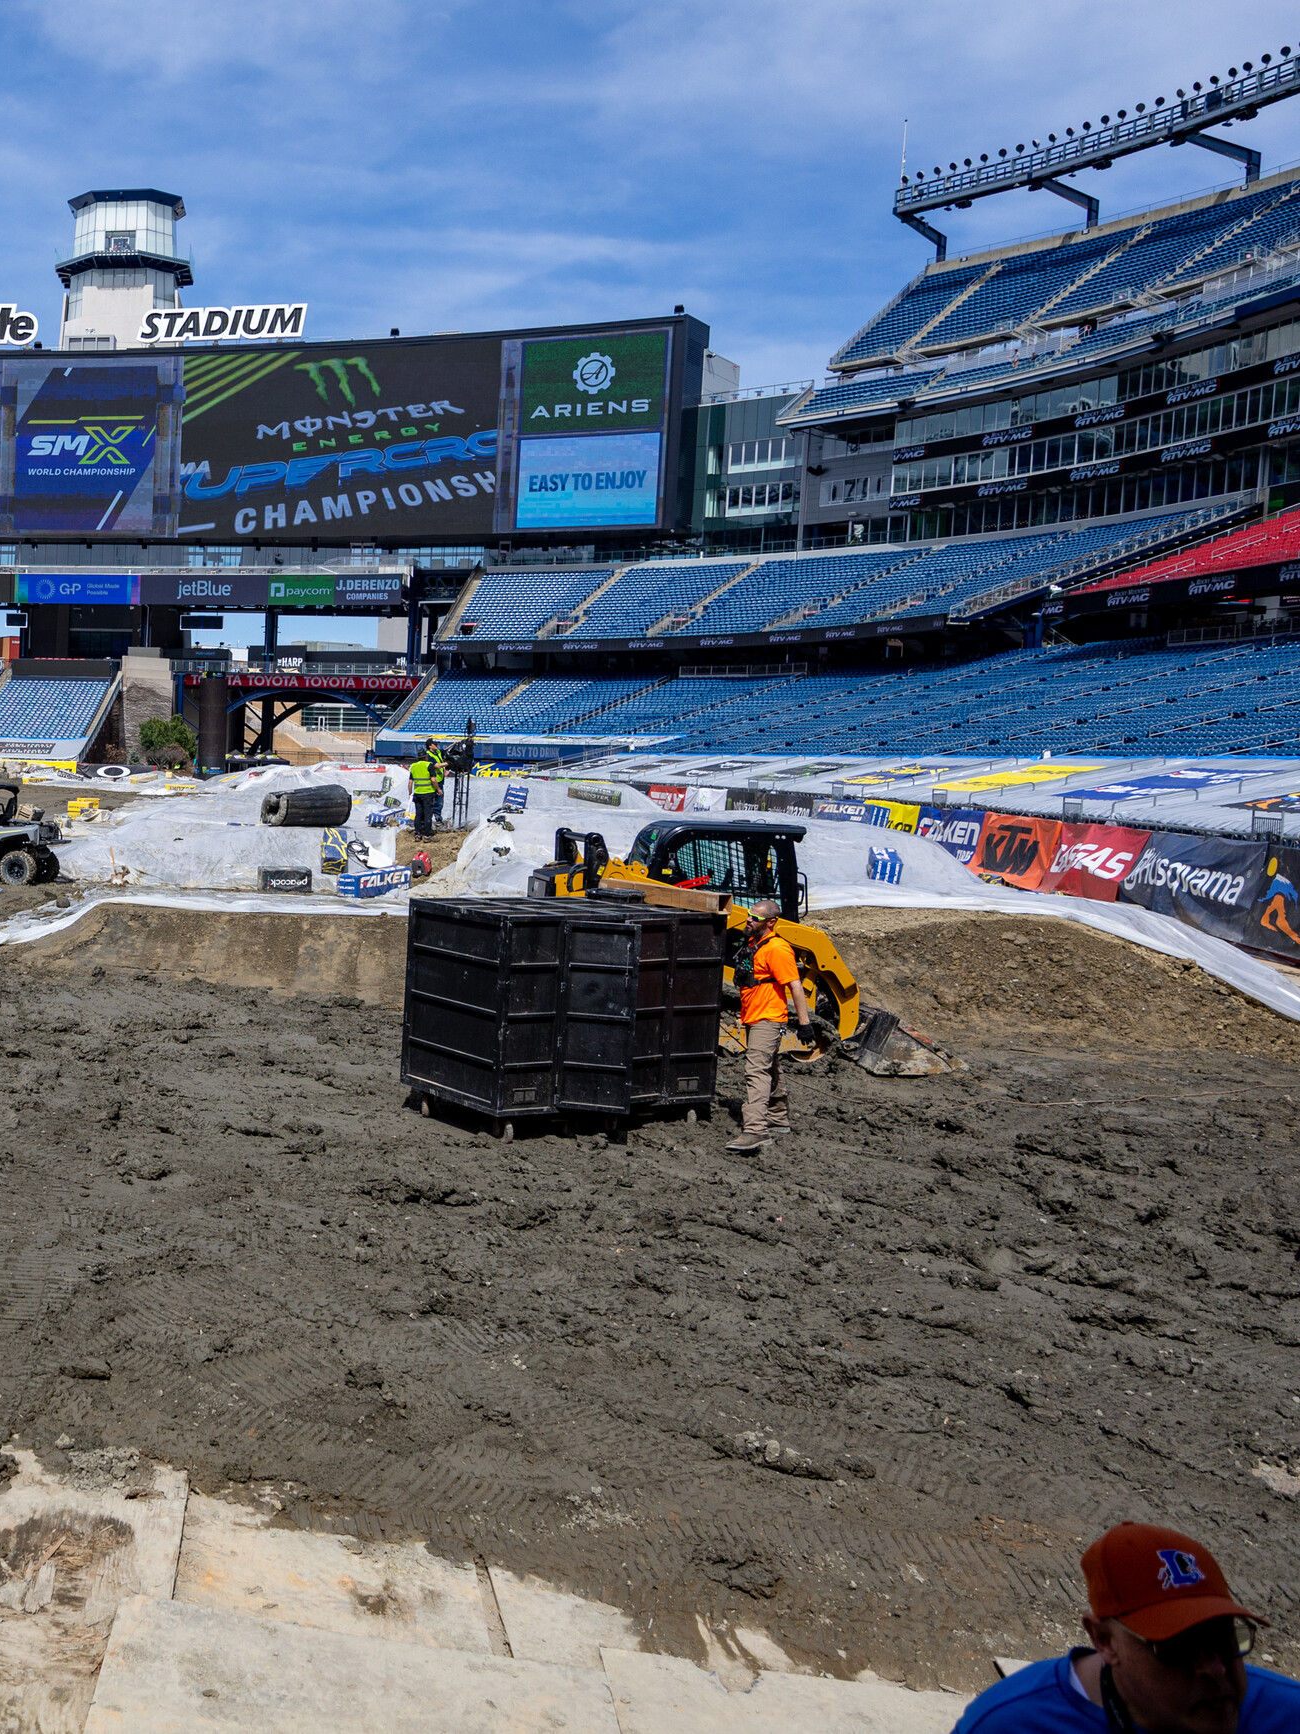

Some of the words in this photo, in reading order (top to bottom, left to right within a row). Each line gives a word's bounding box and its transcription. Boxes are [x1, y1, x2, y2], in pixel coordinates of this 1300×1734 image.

[140, 307, 304, 339] STADIUM
[530, 399, 650, 419] ARIENS
[256, 399, 465, 440] MONSTER
[27, 425, 137, 465] SMX
[292, 422, 441, 452] ENERGY
[28, 467, 61, 476] WORLD
[63, 467, 136, 476] CHAMPIONSHIP
[528, 472, 568, 493] EASY
[572, 472, 593, 491] TO
[595, 470, 647, 490] ENJOY
[177, 580, 232, 600] jetBlue
[286, 587, 330, 598] paycom
[336, 579, 400, 592] J.DERENZO
[346, 592, 388, 601] COMPANIES
[282, 657, 303, 667] HARP
[247, 676, 299, 687] TOYOTA
[304, 676, 356, 688] TOYOTA
[361, 677, 414, 689] TOYOTA
[506, 746, 527, 757] EASY
[528, 746, 538, 757] TO
[818, 803, 866, 816] FALKEN
[917, 817, 981, 846] FALKEN
[977, 824, 1040, 876] KTM
[360, 869, 411, 890] FALKEN
